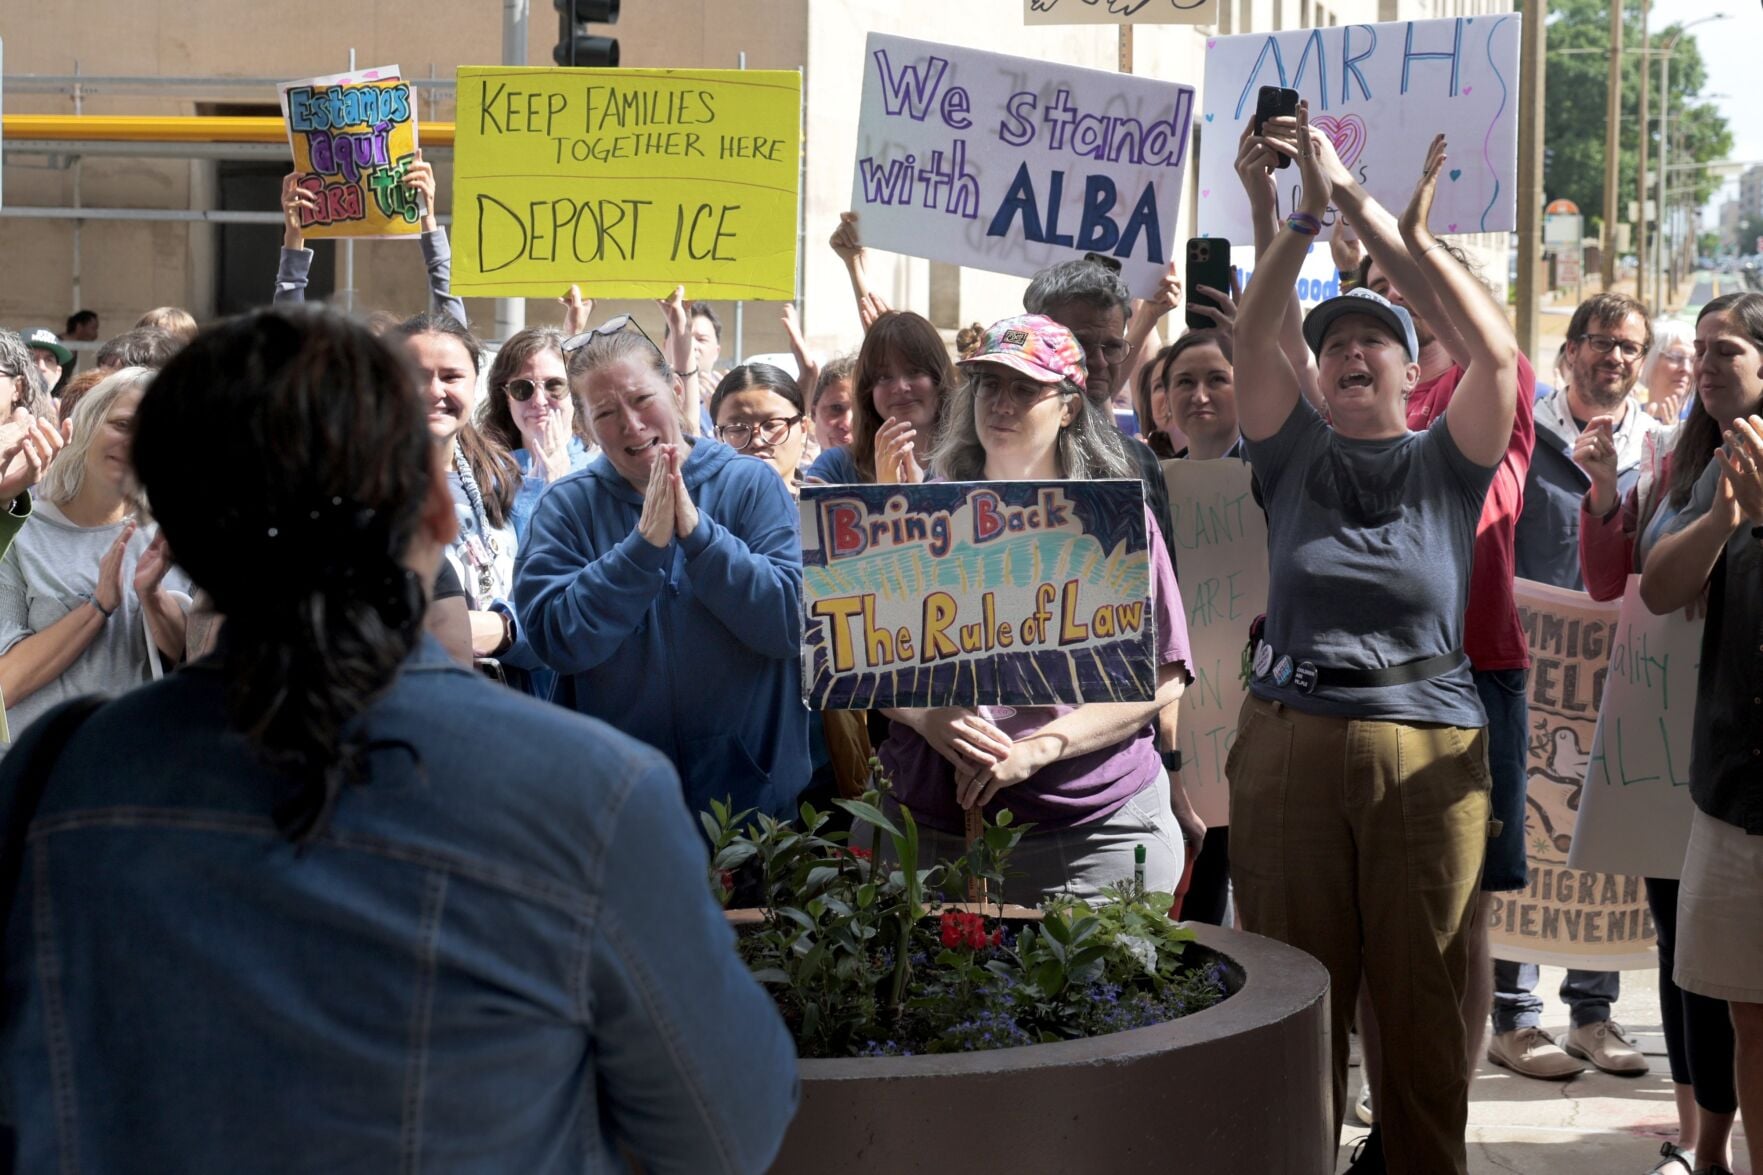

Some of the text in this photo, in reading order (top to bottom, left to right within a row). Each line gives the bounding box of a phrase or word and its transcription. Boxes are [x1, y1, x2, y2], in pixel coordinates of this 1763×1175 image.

[288, 85, 411, 132] Estamos
[480, 80, 716, 136] KEEP FAMILIES
[873, 48, 973, 130] We
[308, 121, 395, 183] aquí
[551, 132, 786, 164] TOGETHER HERE
[859, 139, 980, 219] with
[986, 160, 1165, 265] ALBA
[476, 194, 741, 273] DEPORT ICE
[823, 490, 1068, 559] Bring Back
[812, 578, 1144, 673] The Rule of Law
[1191, 570, 1245, 627] ARE
[1517, 606, 1618, 661] MMIG
[1506, 867, 1651, 905] MIGRAN
